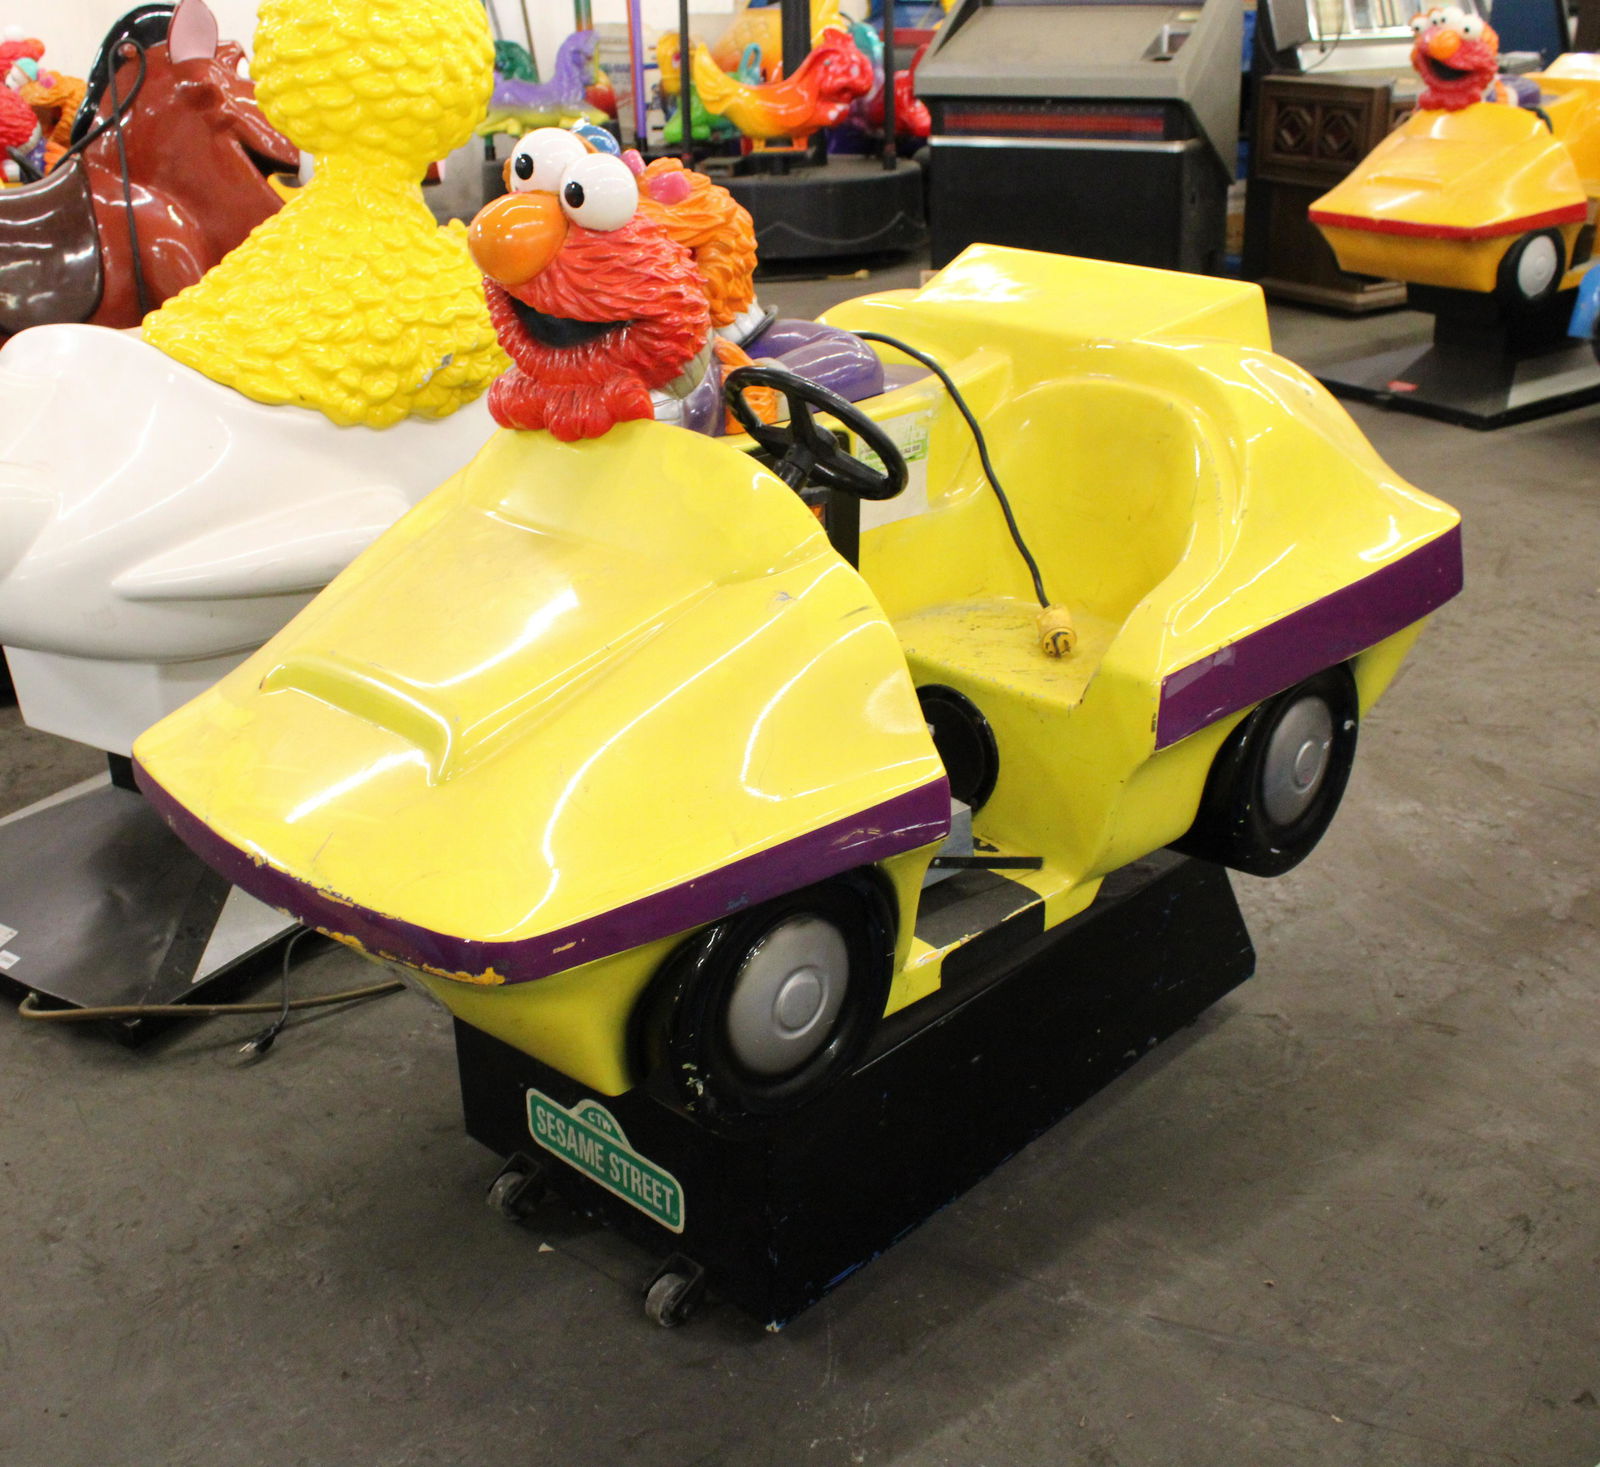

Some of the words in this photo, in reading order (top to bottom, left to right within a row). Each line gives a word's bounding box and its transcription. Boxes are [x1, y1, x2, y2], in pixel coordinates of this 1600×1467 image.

[588, 1111, 612, 1132] CTW
[536, 1105, 605, 1173] SESAME
[609, 1152, 674, 1215] STREET
